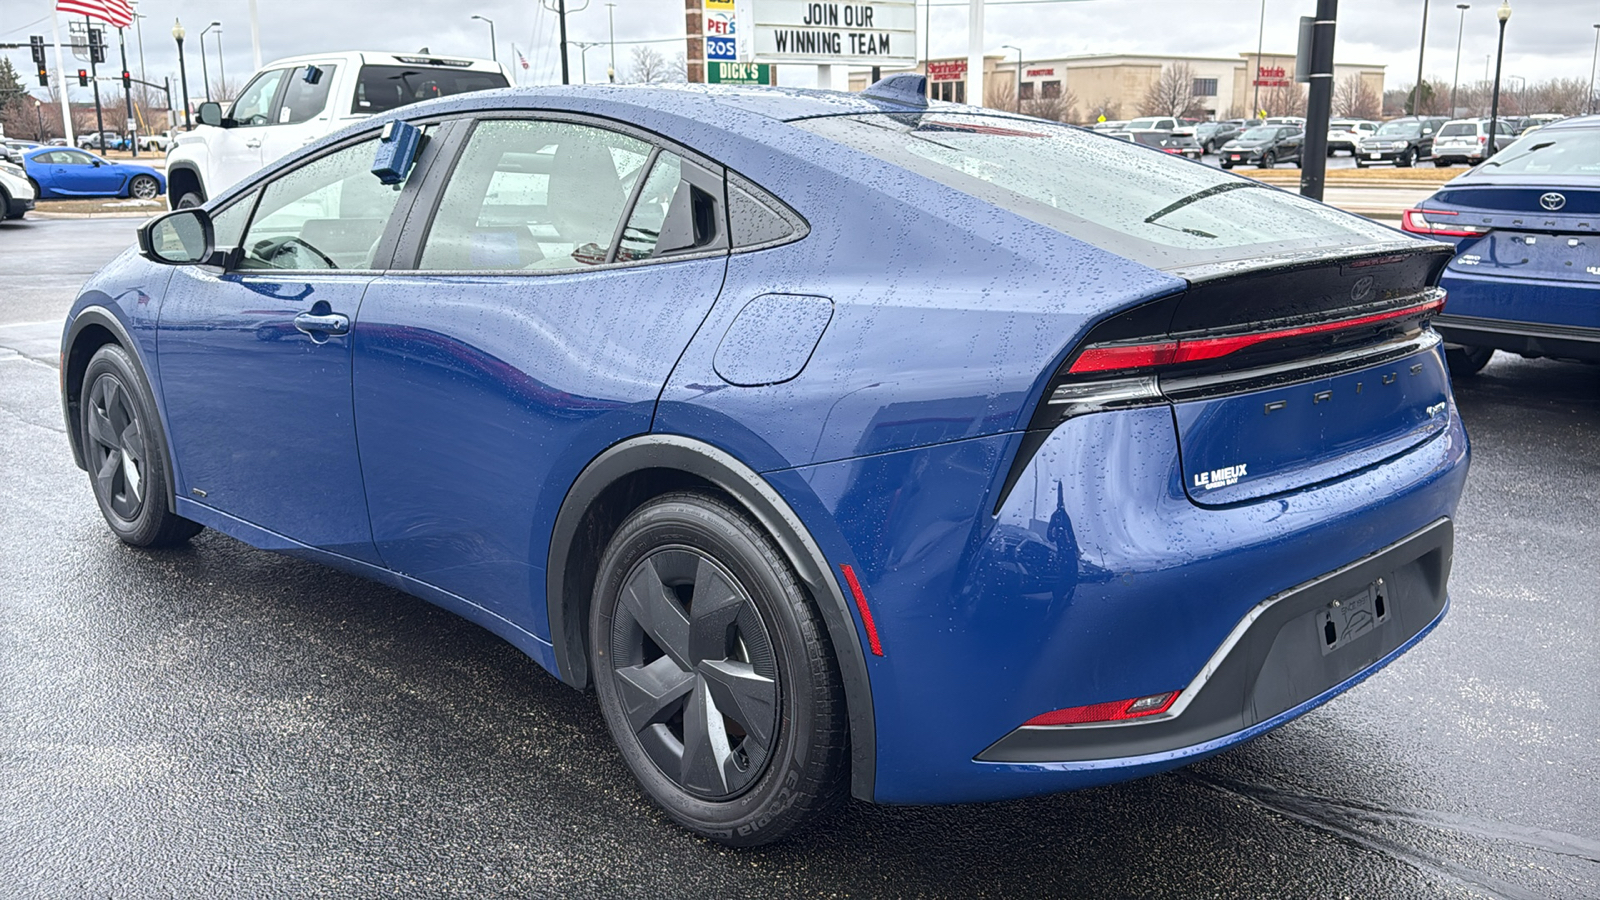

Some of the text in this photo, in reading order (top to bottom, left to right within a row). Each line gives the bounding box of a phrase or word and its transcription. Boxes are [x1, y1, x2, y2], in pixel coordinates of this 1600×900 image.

[803, 3, 873, 28] JOIN OUR
[774, 29, 890, 55] WINNING TEAM
[719, 62, 759, 79] DICK'S
[1264, 363, 1422, 415] PRIUS
[1194, 463, 1248, 487] LE MIEUX
[1205, 477, 1238, 490] GREEN BAY
